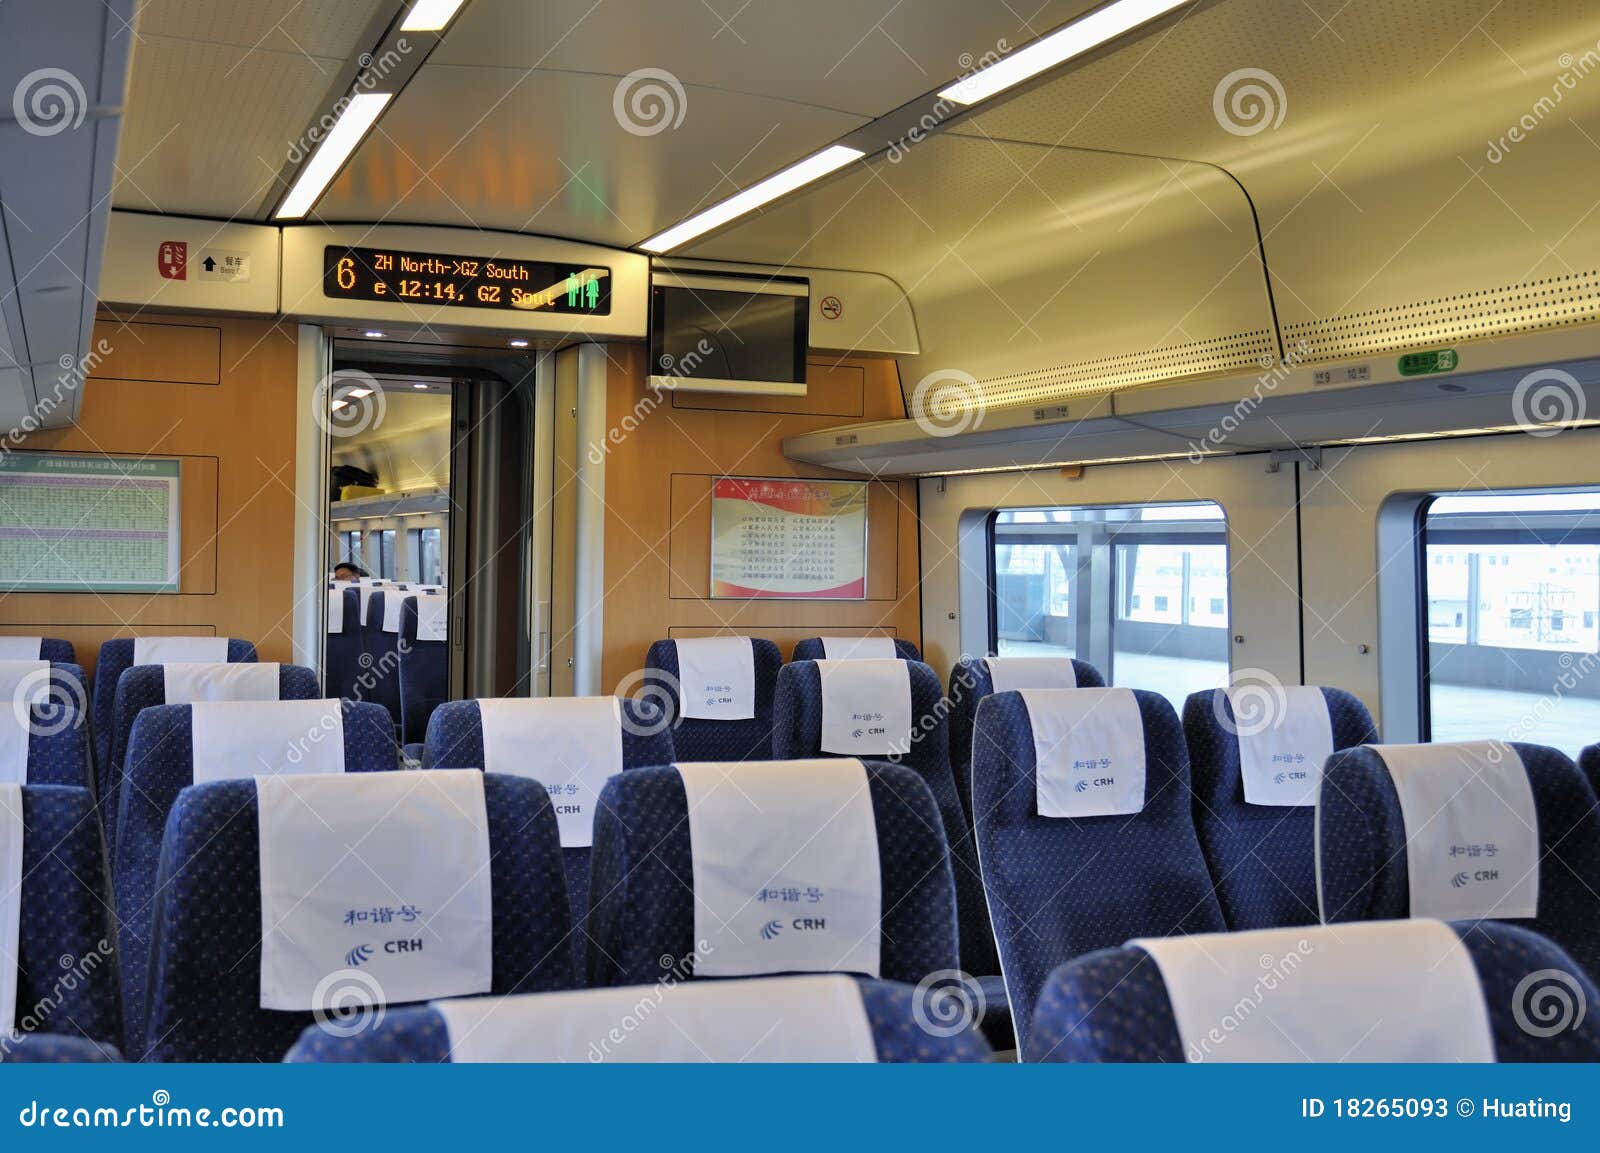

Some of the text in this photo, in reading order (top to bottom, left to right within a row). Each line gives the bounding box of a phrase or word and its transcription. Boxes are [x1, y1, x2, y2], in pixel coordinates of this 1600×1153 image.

[337, 258, 356, 289] 6
[374, 255, 393, 271] ZH
[486, 263, 529, 281] South
[374, 281, 555, 307] e 12:14, GZ Sout
[867, 727, 885, 735] CRH
[1093, 777, 1114, 787] CRH
[1288, 771, 1306, 780] CRH
[555, 805, 581, 814] CRH
[1474, 870, 1499, 881] CRH
[757, 887, 824, 903] 和谐号
[343, 904, 422, 926] 和谐号
[792, 918, 825, 930] CRH
[384, 938, 423, 954] CRH
